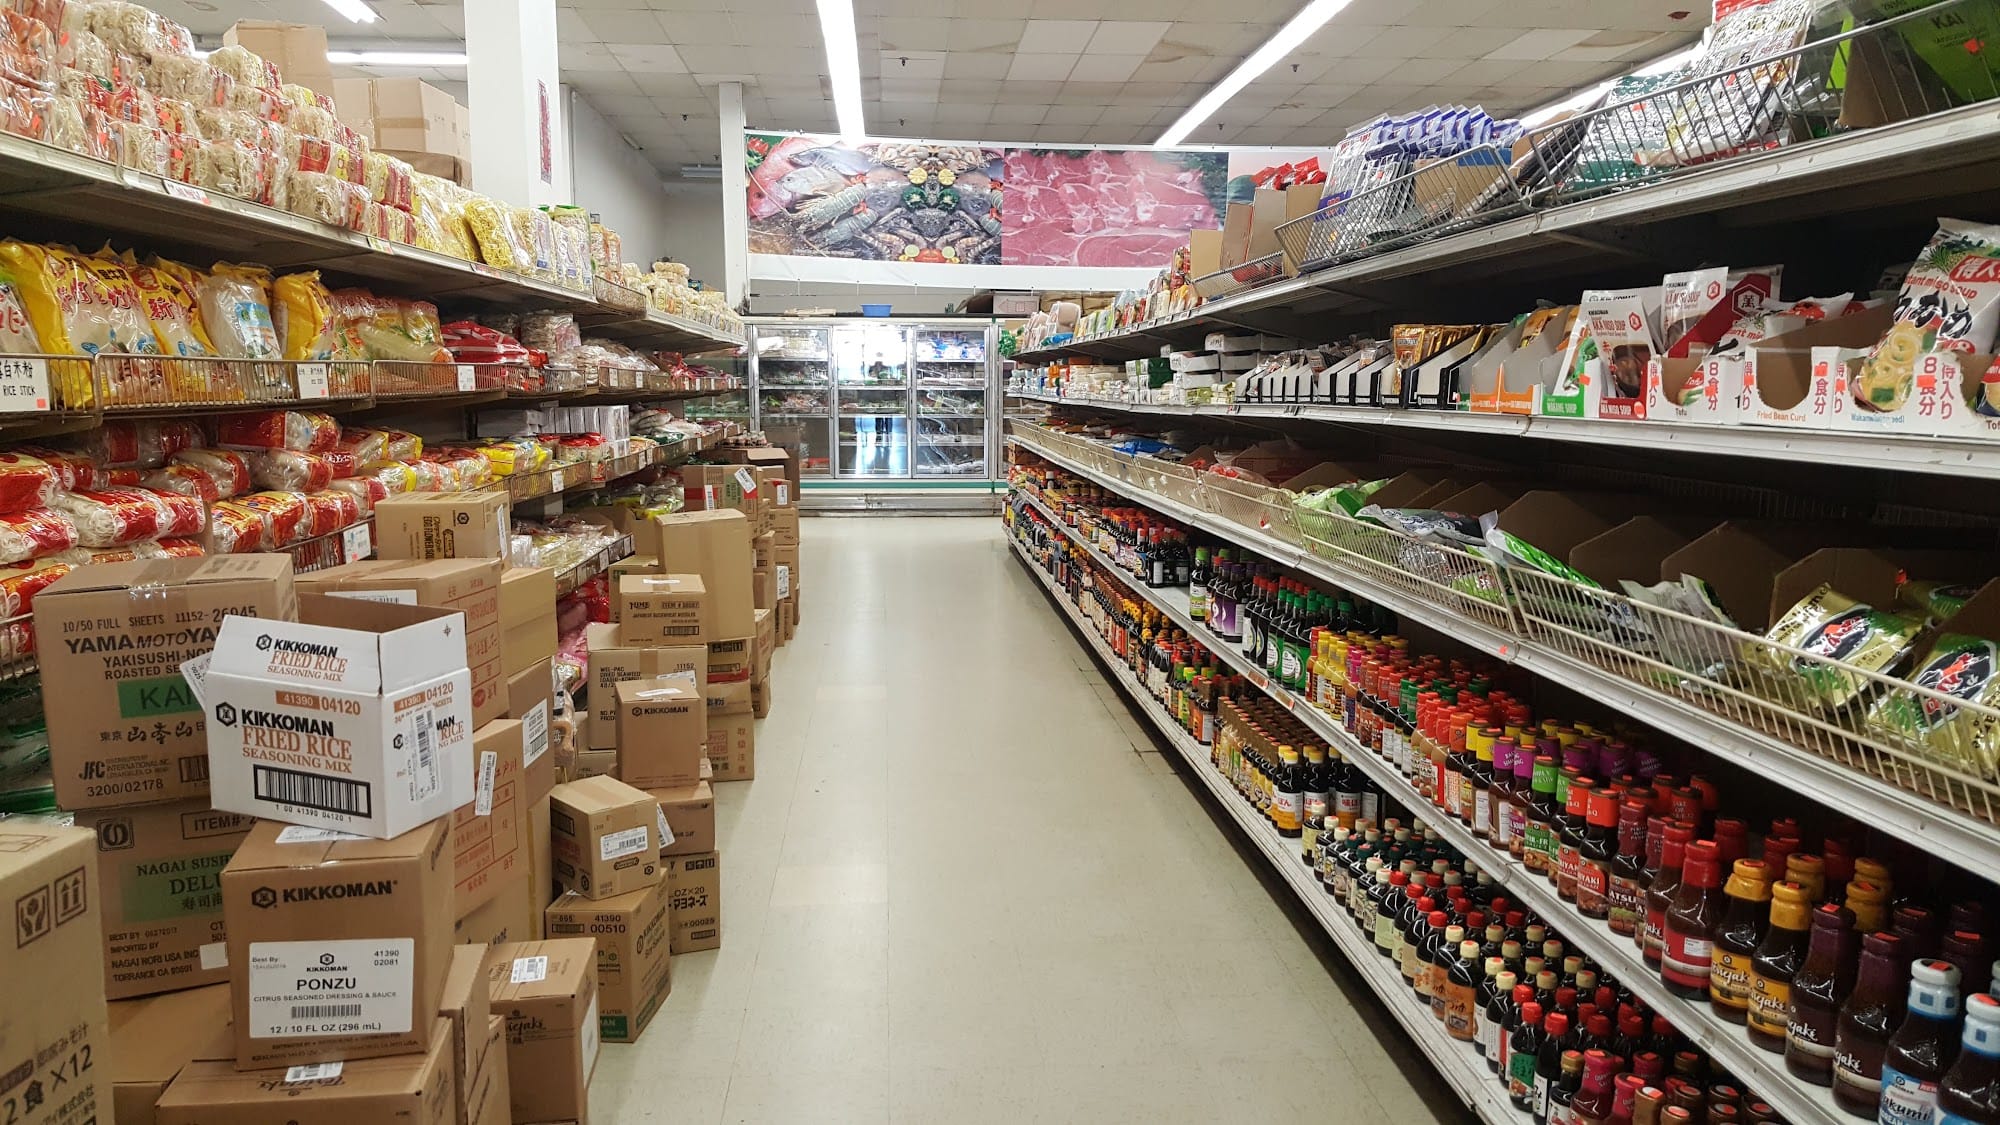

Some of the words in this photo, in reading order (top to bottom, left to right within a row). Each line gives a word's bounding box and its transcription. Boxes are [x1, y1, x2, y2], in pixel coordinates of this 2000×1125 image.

[1757, 411, 1772, 420] Fried
[1773, 412, 1789, 420] Bean
[63, 619, 93, 633] 10/50
[97, 617, 121, 630] FULL
[129, 614, 165, 627] SHEETS
[64, 626, 219, 655] YAMAMOTOYA
[274, 639, 338, 658] KIKKOMAN
[270, 651, 312, 669] FRIED
[313, 654, 348, 673] RICE
[105, 665, 161, 680] ROASTED
[267, 664, 321, 680] SEASONING
[323, 672, 343, 682] MIX
[426, 681, 454, 701] 04120
[284, 693, 314, 706] 41390
[321, 697, 361, 715] 04120
[644, 707, 688, 715] KIKKOMAN
[241, 709, 334, 737] KIKKOMAN
[440, 721, 464, 741] RICE
[242, 726, 300, 752] FRIED
[306, 733, 352, 760] RICE
[242, 747, 321, 769] SEASONING
[325, 759, 352, 773] MIX
[78, 760, 106, 780] JFC
[87, 779, 164, 797] 3200/02178
[137, 861, 186, 877] NAGAI
[283, 880, 393, 903] KIKKOMAN
[590, 924, 626, 933] 00510
[111, 958, 139, 969] NAGAI
[164, 952, 181, 963] USA
[374, 950, 400, 958] 41390
[113, 969, 156, 981] TORRANCE
[157, 968, 169, 977] CA
[296, 977, 357, 991] PONZU
[325, 992, 363, 1000] DRESSING
[372, 991, 397, 999] SAUCE
[270, 1026, 281, 1034] 12
[291, 1025, 302, 1033] 10
[306, 1024, 318, 1032] FL
[321, 1023, 336, 1032] OZ
[338, 1022, 359, 1032] (296
[362, 1022, 382, 1031] mL)
